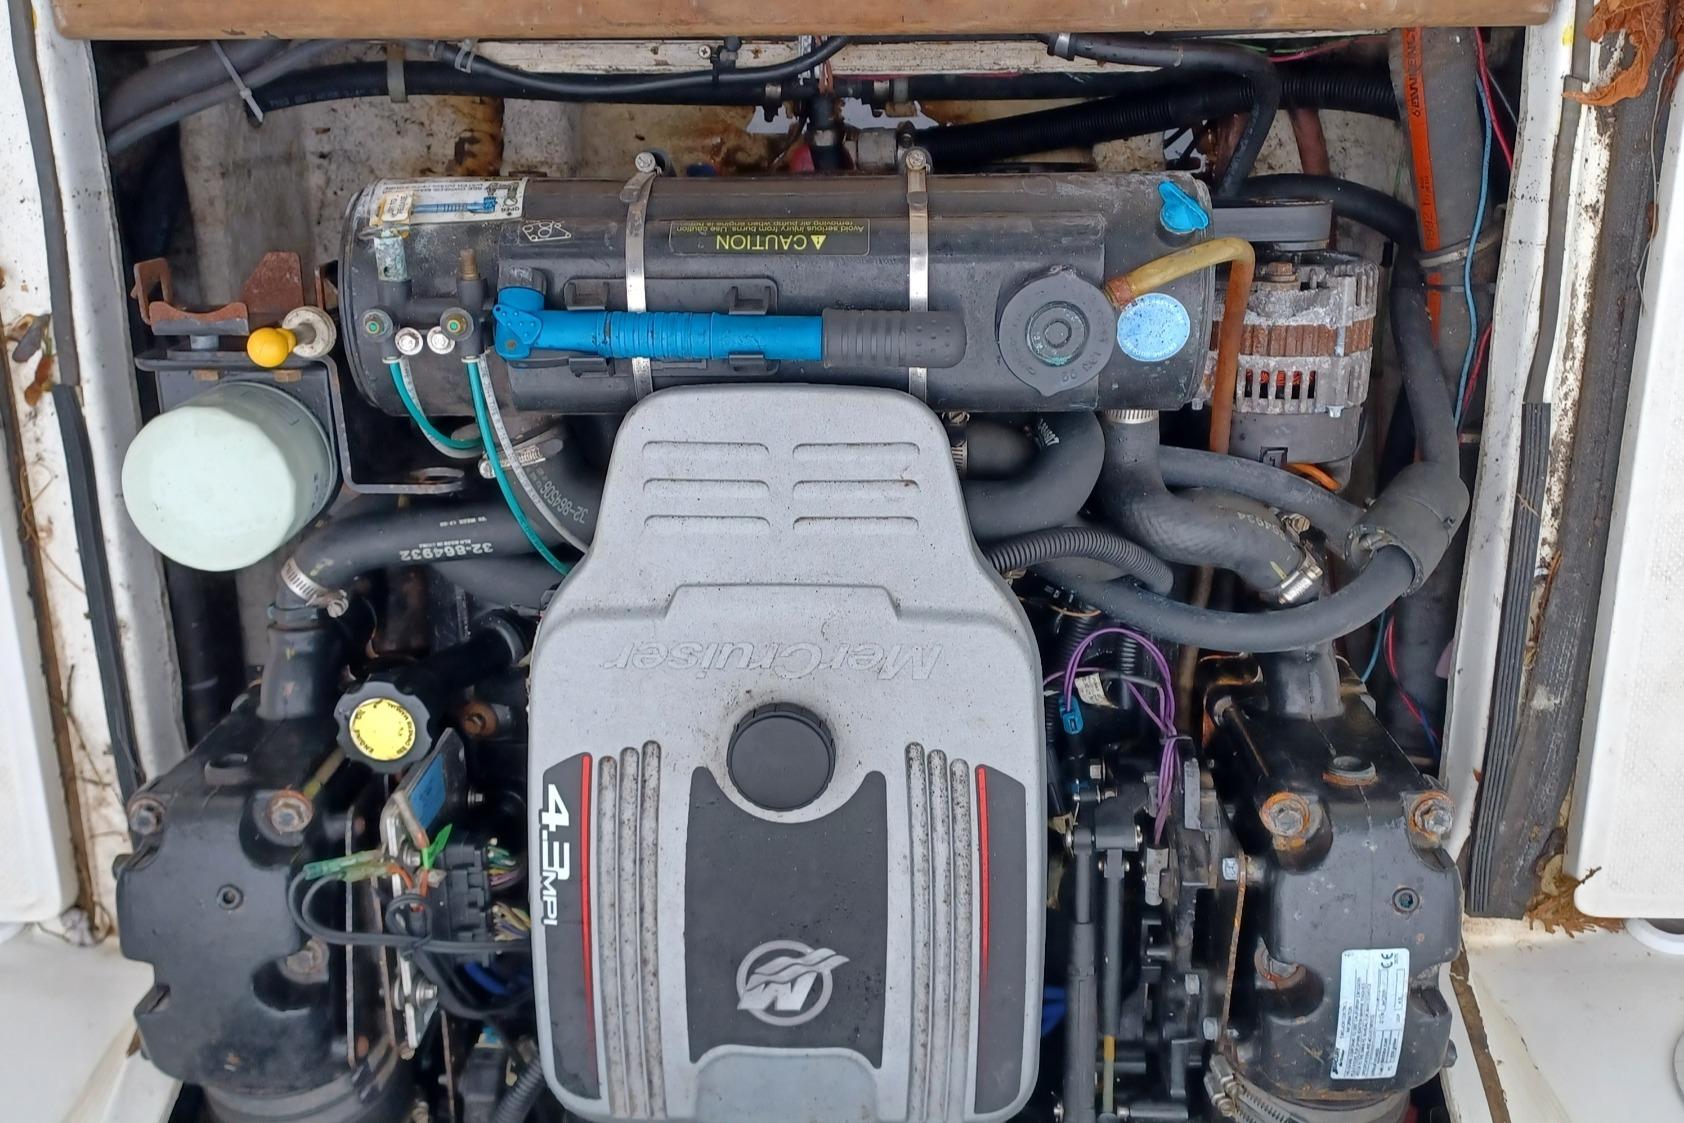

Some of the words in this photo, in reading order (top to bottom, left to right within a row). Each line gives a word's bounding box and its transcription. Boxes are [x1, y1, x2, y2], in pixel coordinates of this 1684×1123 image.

[715, 234, 808, 250] CAUTION
[780, 224, 804, 232] injury
[540, 481, 589, 523] 32-864506
[399, 543, 493, 562] 32-864932
[599, 641, 944, 681] MerCruiser
[354, 729, 374, 753] ENGINE
[541, 783, 570, 881] 4.3
[541, 871, 558, 926] MPI
